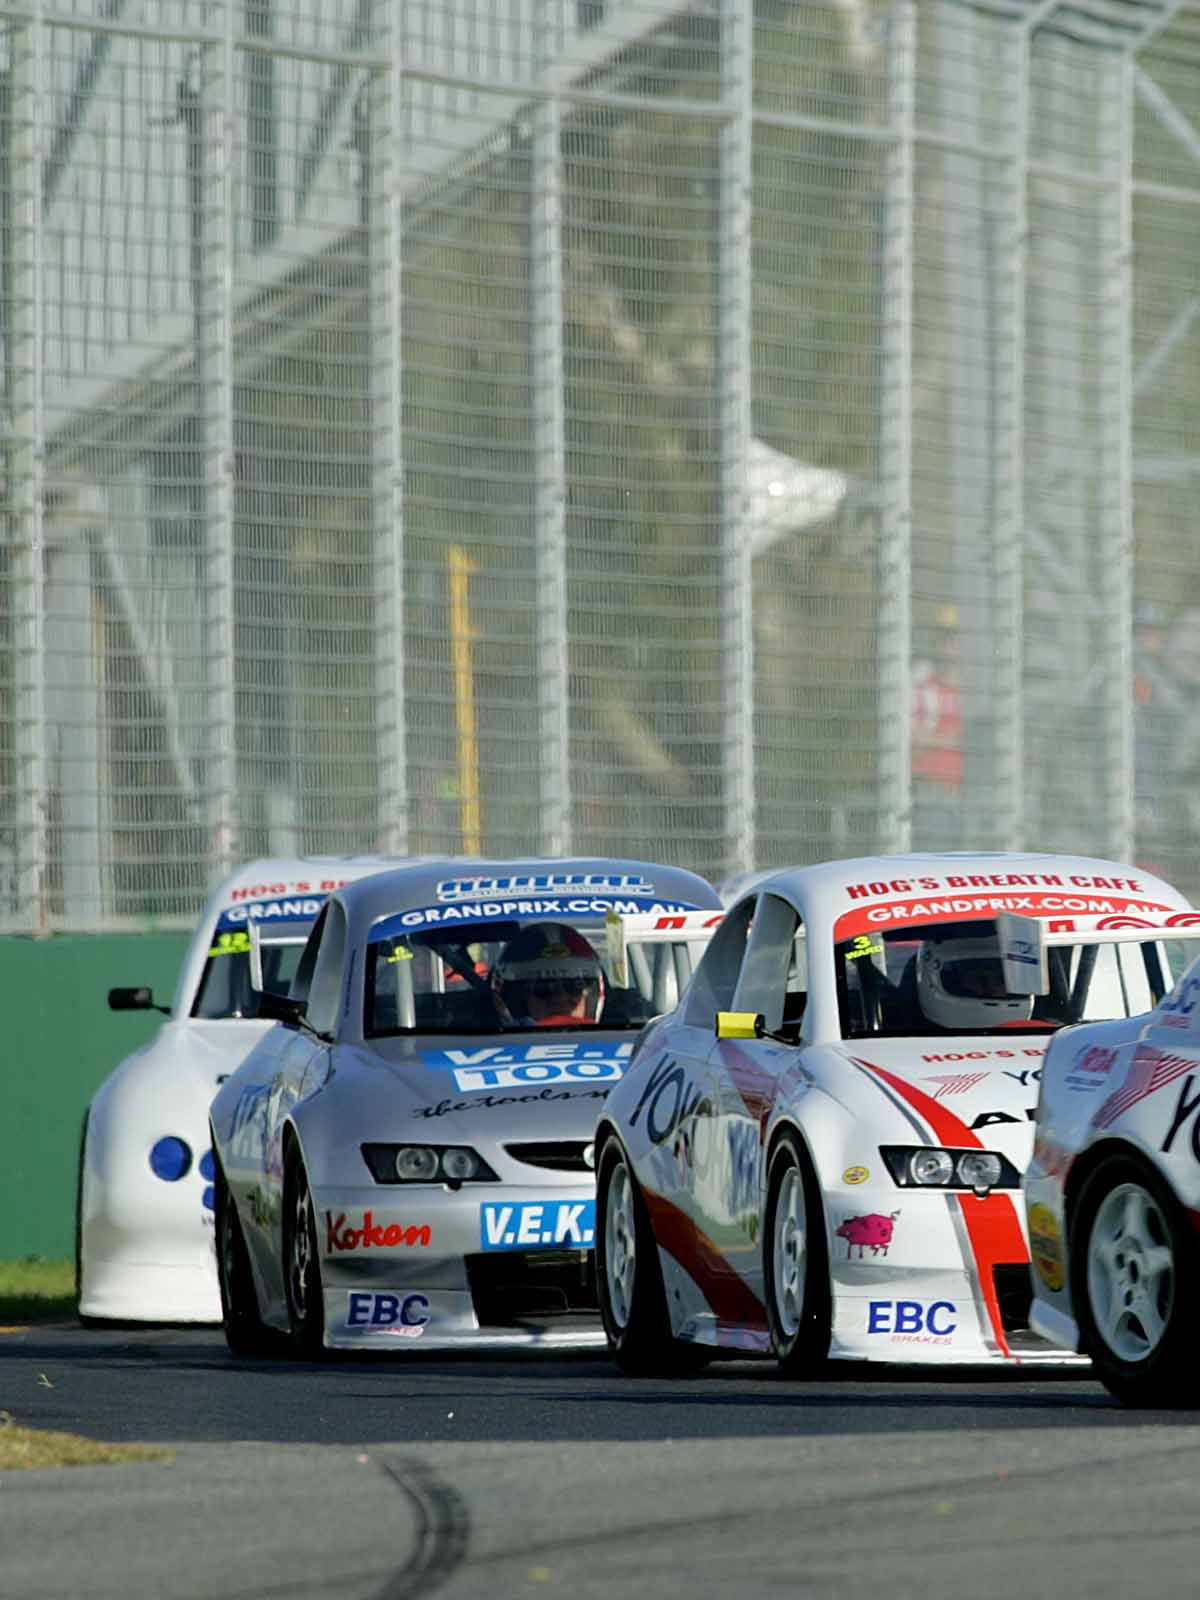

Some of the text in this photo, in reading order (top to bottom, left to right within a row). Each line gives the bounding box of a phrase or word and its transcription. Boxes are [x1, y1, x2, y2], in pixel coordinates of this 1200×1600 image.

[846, 874, 1144, 900] HOG'S BREATH CAFE
[227, 900, 322, 922] GRAND
[866, 897, 1161, 923] GRANDPRIX.COM.AU
[853, 935, 872, 949] 3
[920, 1049, 1015, 1064] HOG'S
[463, 1062, 622, 1086] TOO
[325, 1209, 432, 1254] Koken
[485, 1204, 595, 1245] V.E.K.
[347, 1293, 429, 1328] EBC
[868, 1300, 957, 1336] EBC
